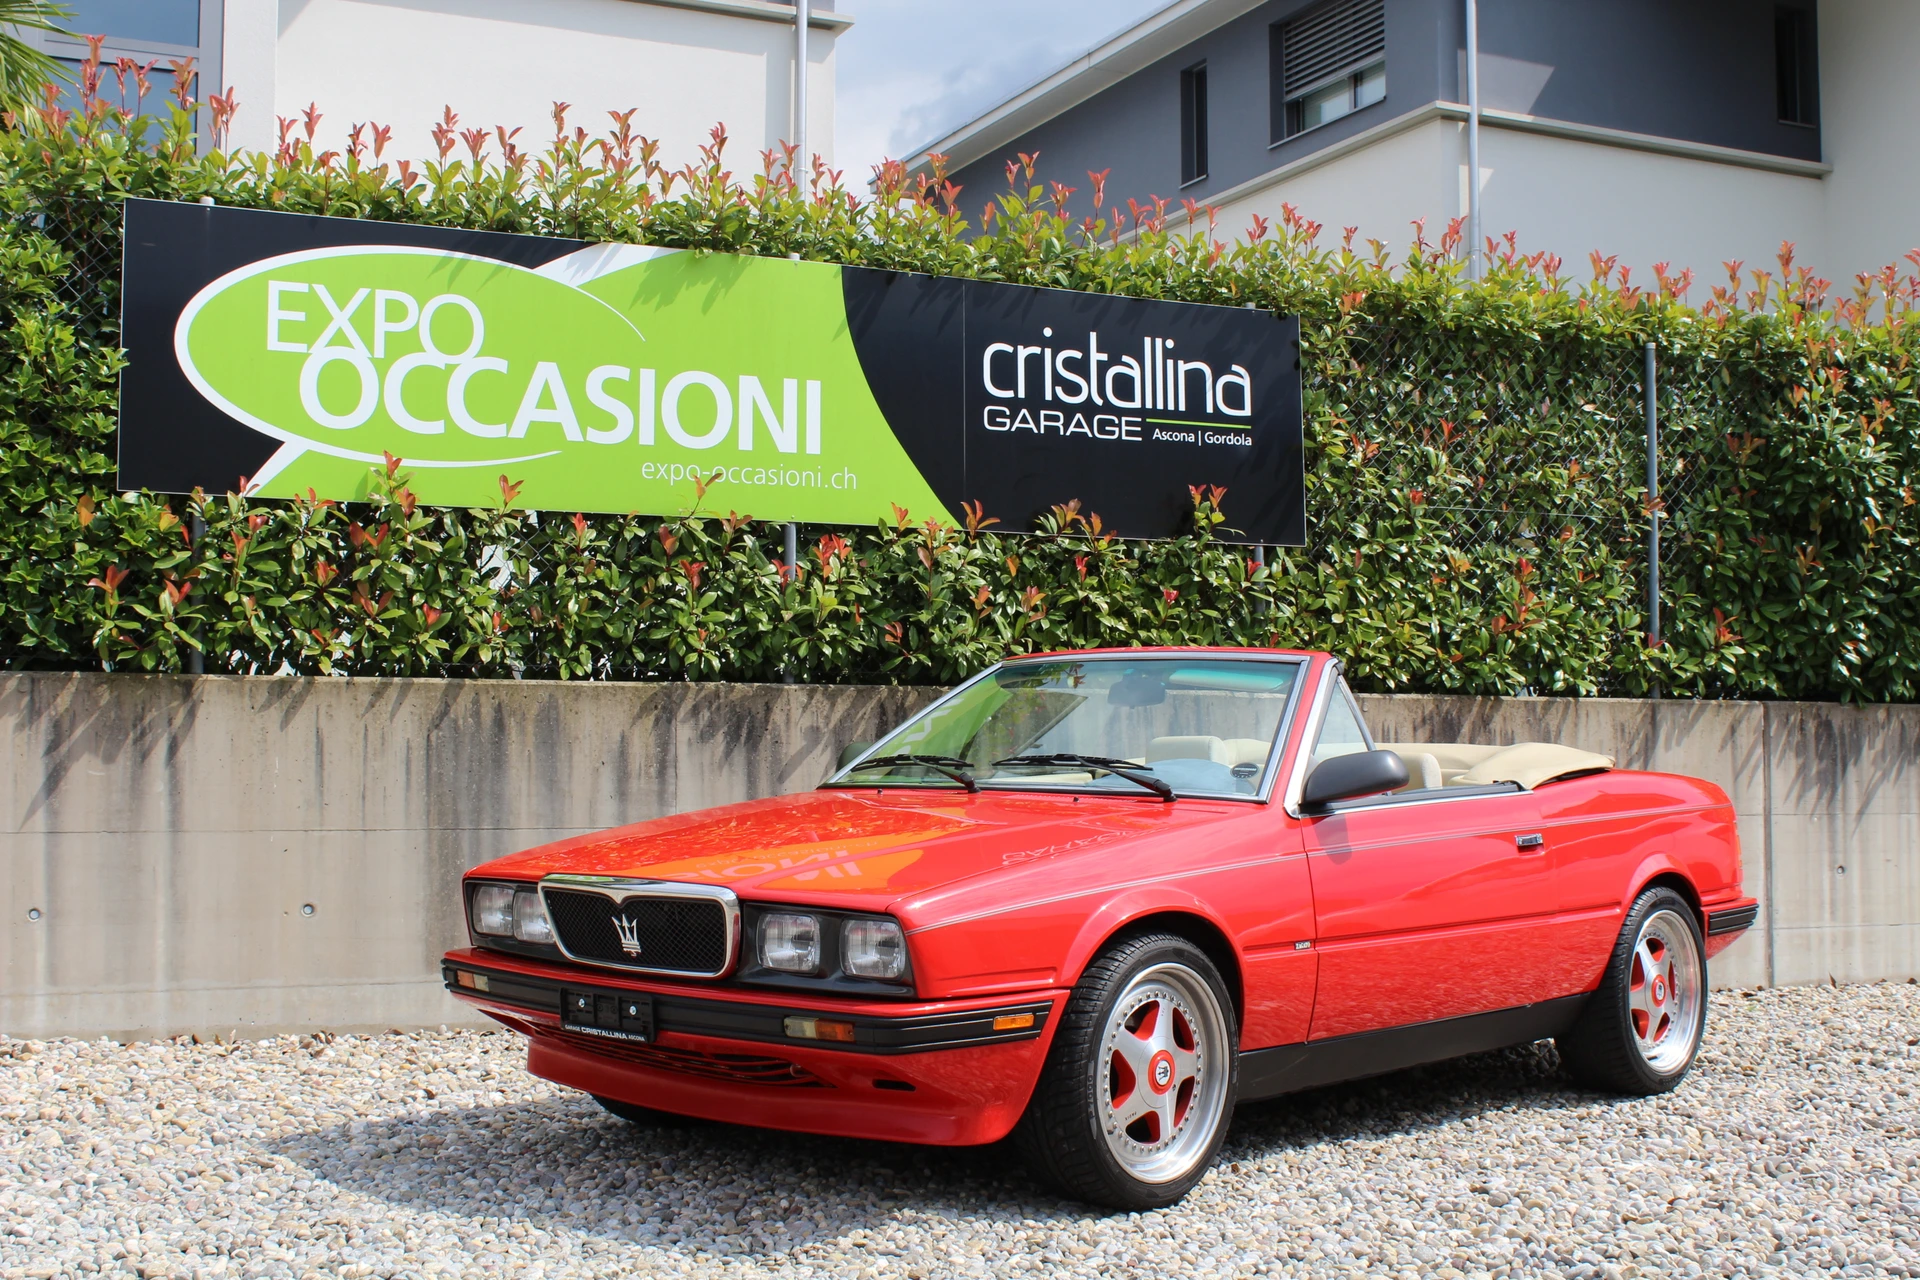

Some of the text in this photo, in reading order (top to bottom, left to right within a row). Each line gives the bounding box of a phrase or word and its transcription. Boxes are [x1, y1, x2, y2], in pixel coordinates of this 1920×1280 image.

[266, 280, 485, 365] EXPO
[299, 345, 822, 456] OCCASIONI
[983, 327, 1252, 417] cristallina
[983, 405, 1143, 441] GARAGE
[1152, 428, 1195, 444] Ascona
[1204, 432, 1252, 447] Gordola
[641, 461, 858, 490] expo-occasioni.ch
[581, 1027, 628, 1040] CRISTALLINA
